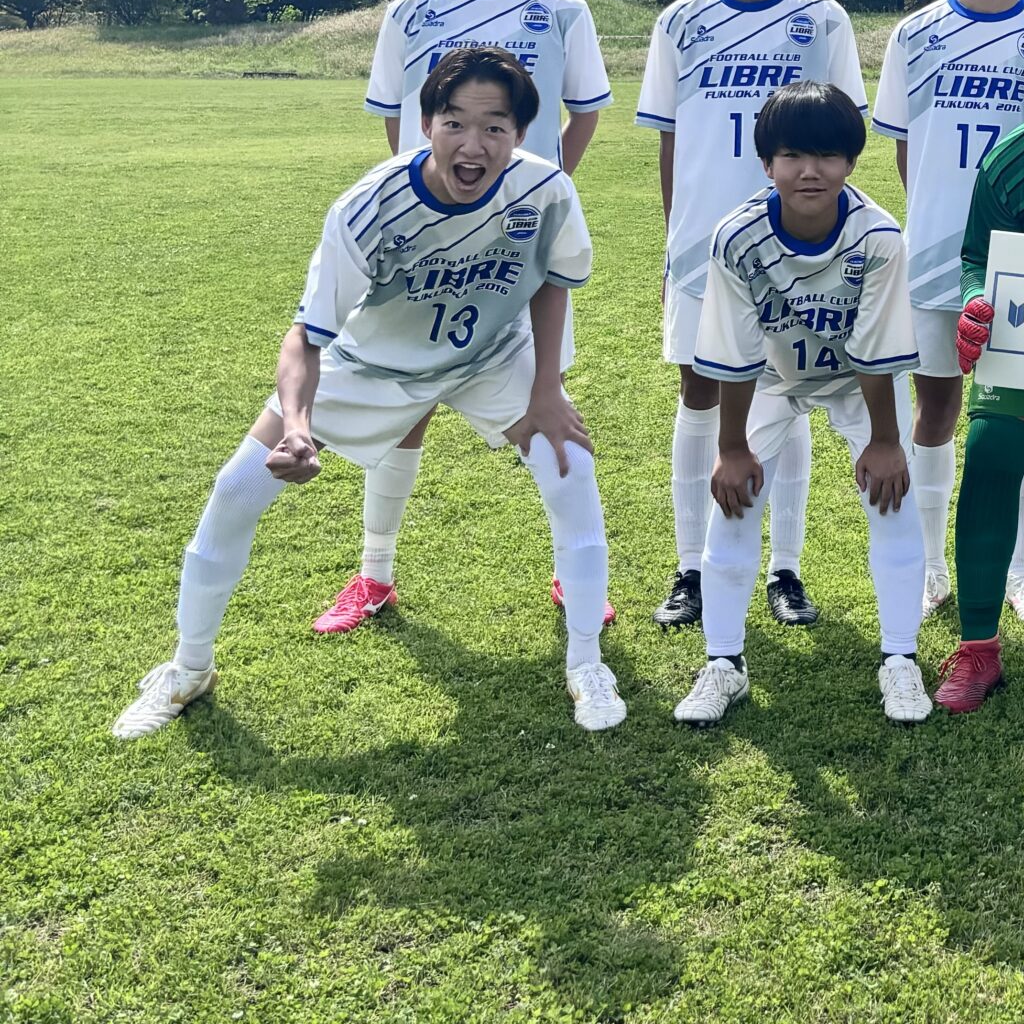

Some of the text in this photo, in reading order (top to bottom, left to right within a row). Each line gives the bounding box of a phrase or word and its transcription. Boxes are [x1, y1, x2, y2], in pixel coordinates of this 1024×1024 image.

[505, 41, 537, 50] CLUB
[709, 54, 801, 62] FOOTBALL CLUB
[940, 63, 998, 73] FOOTBALL
[699, 65, 803, 88] LIBRE
[705, 90, 761, 99] FUKUOKA
[934, 100, 990, 110] FUKUOKA
[957, 123, 1001, 169] 17
[506, 220, 539, 230] LIBRE
[412, 248, 521, 272] FOOTBALL CLUB
[406, 259, 524, 294] LIBRE
[476, 282, 510, 296] 2016
[768, 287, 826, 306] FTBALL
[429, 302, 479, 349] 13
[792, 339, 841, 370] 14
